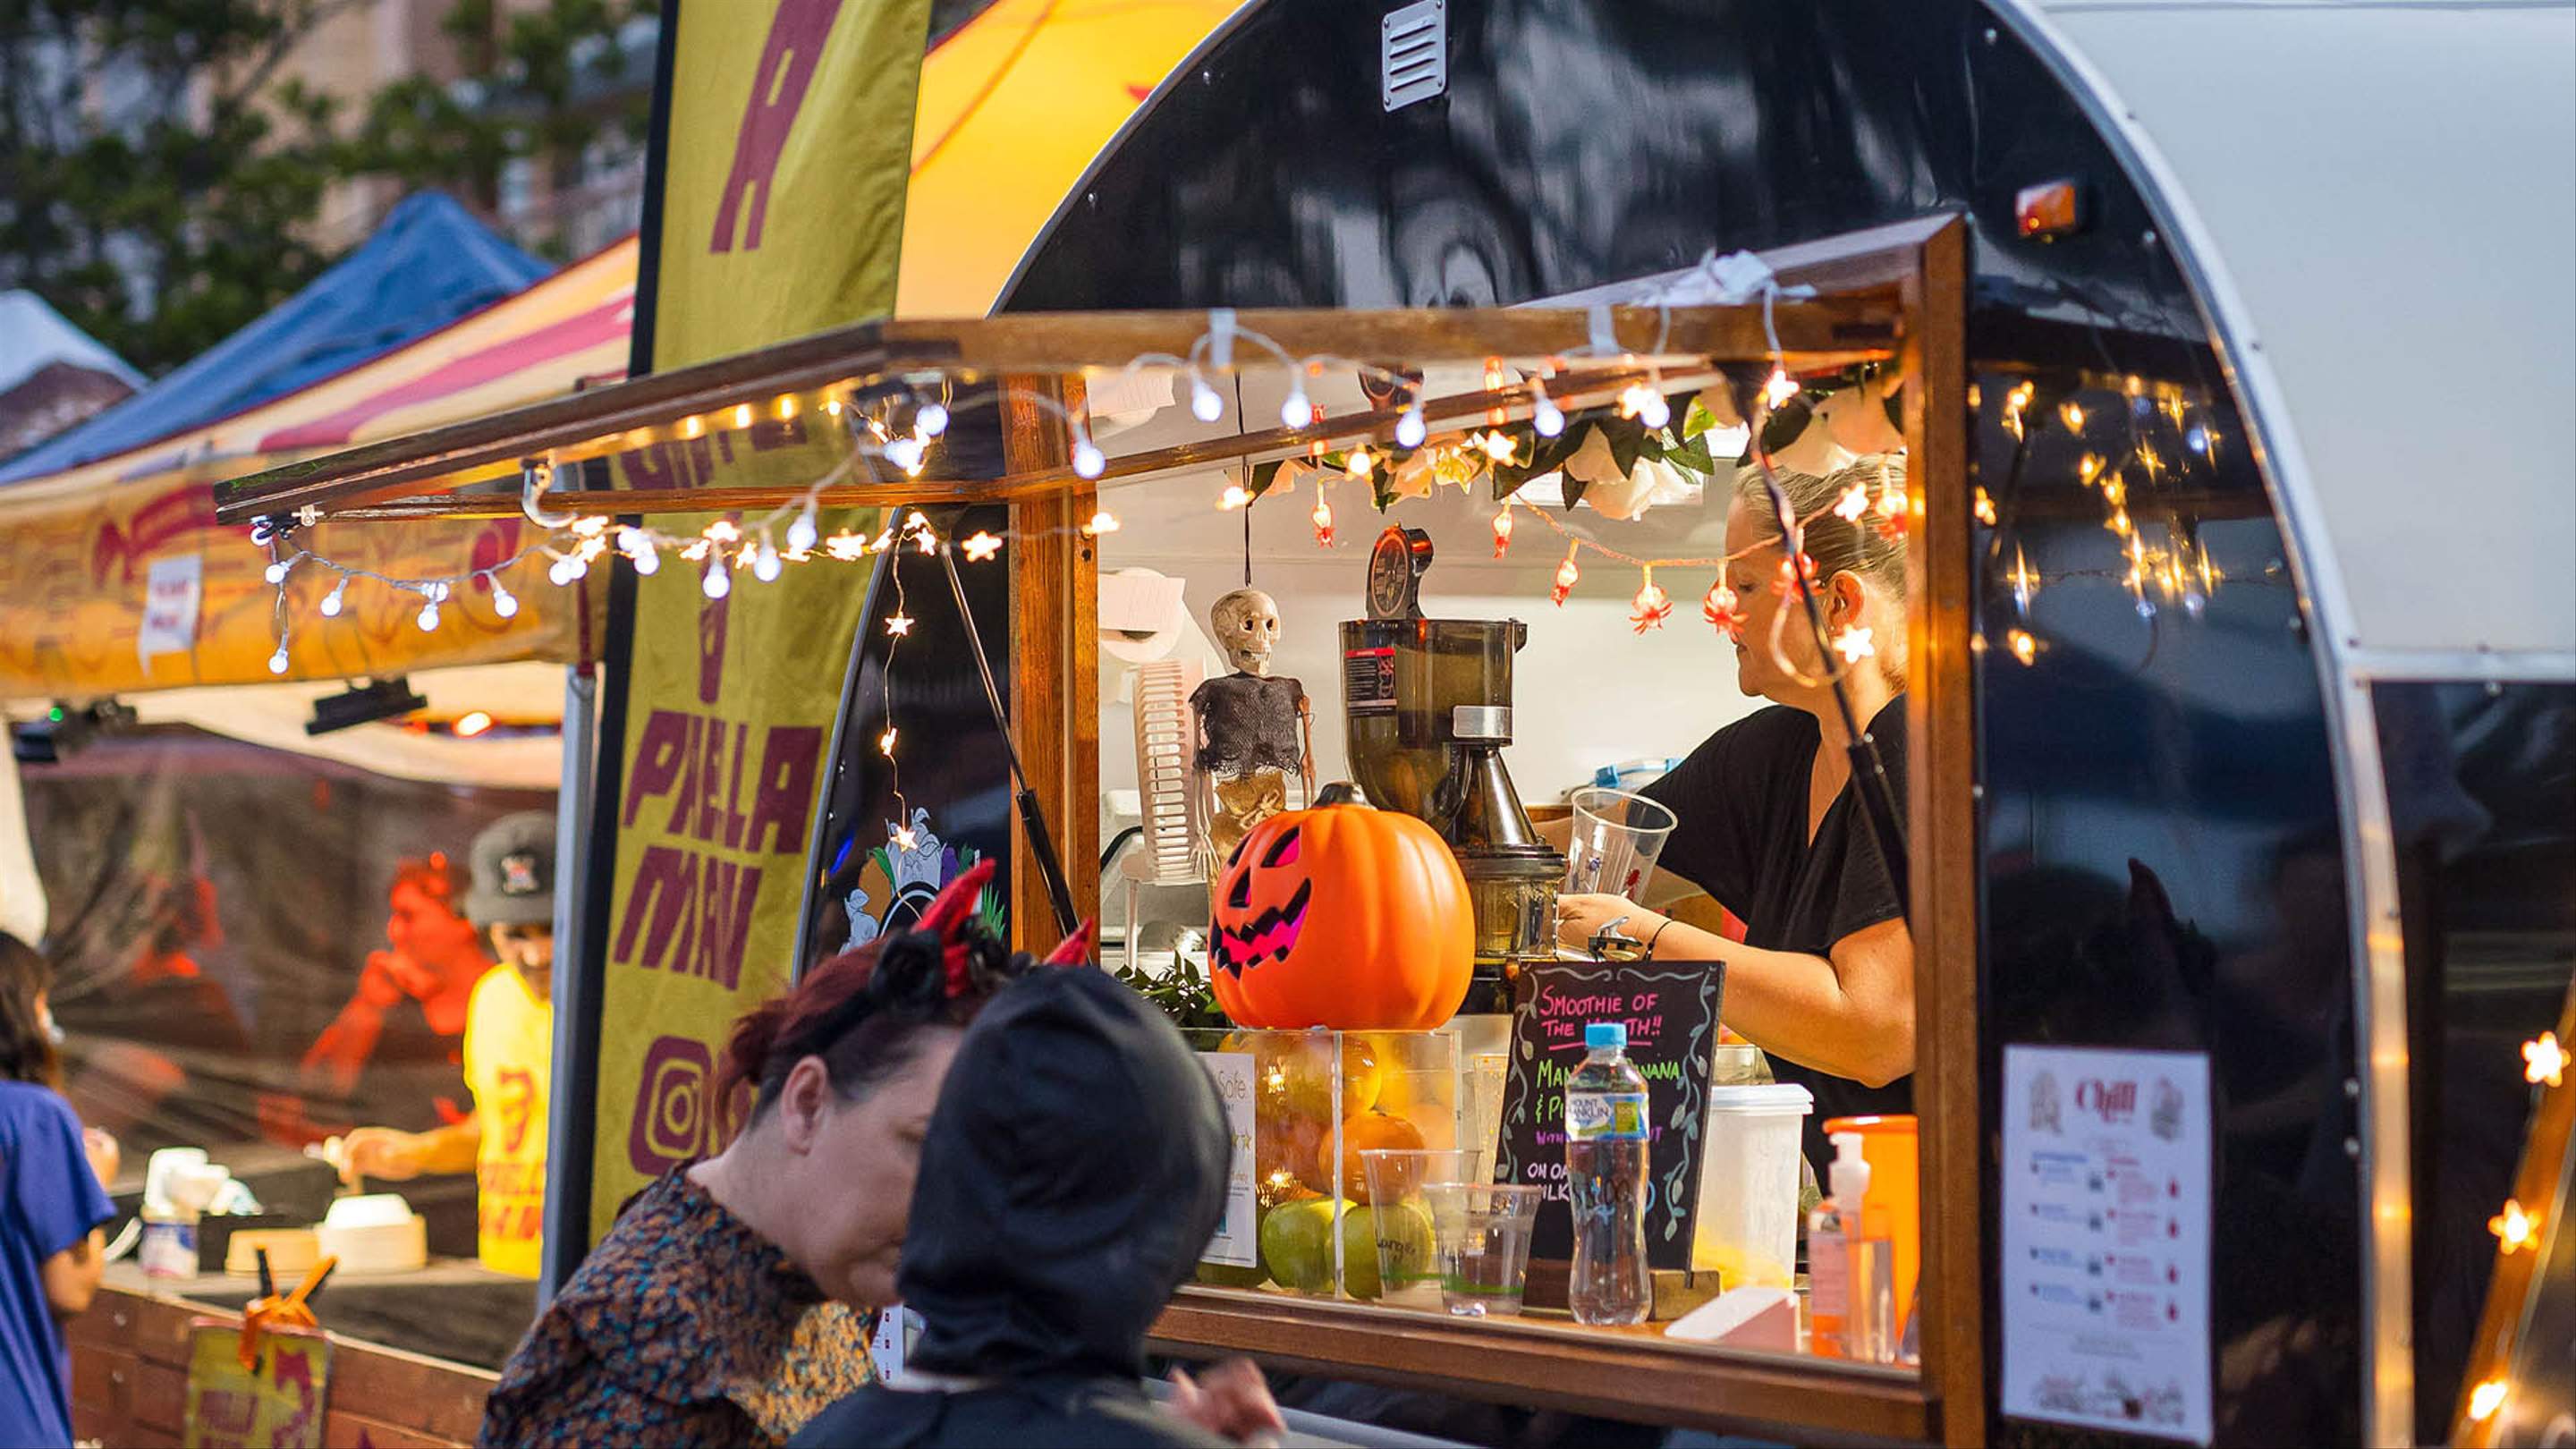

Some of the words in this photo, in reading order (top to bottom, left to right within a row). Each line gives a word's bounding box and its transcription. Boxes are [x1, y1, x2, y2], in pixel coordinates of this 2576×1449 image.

[1539, 985, 1623, 1017] SMOOTHIE
[1631, 994, 1659, 1013] OF
[1541, 1020, 1576, 1038] THE
[1572, 1097, 1598, 1109] OUNT
[1527, 1162, 1547, 1180] ON
[1550, 1162, 1569, 1181] OA
[1537, 1183, 1571, 1203] ILK
